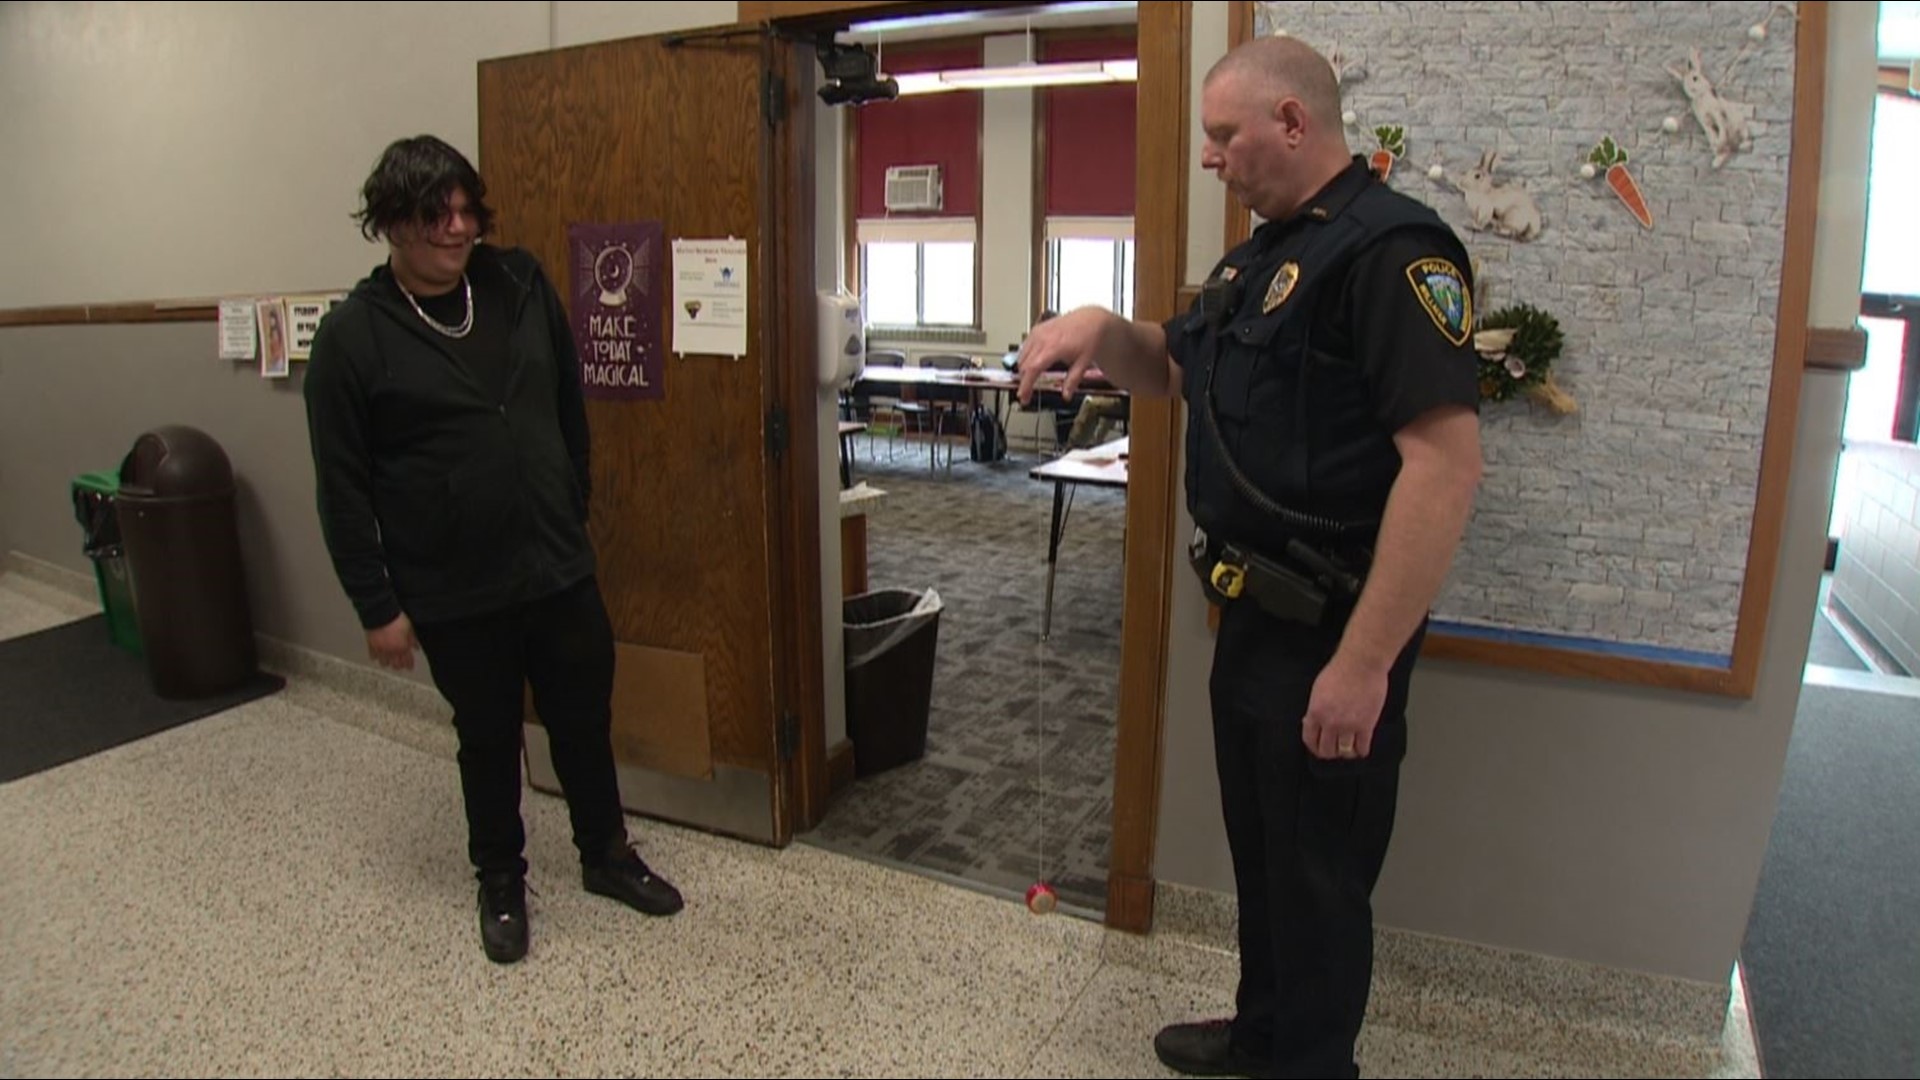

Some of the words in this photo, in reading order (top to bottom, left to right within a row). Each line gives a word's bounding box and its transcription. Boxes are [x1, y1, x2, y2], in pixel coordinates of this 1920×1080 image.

[1422, 263, 1457, 277] POLICE
[590, 315, 637, 338] MAKE
[593, 340, 631, 362] TODAY
[584, 362, 649, 387] MAGICAL
